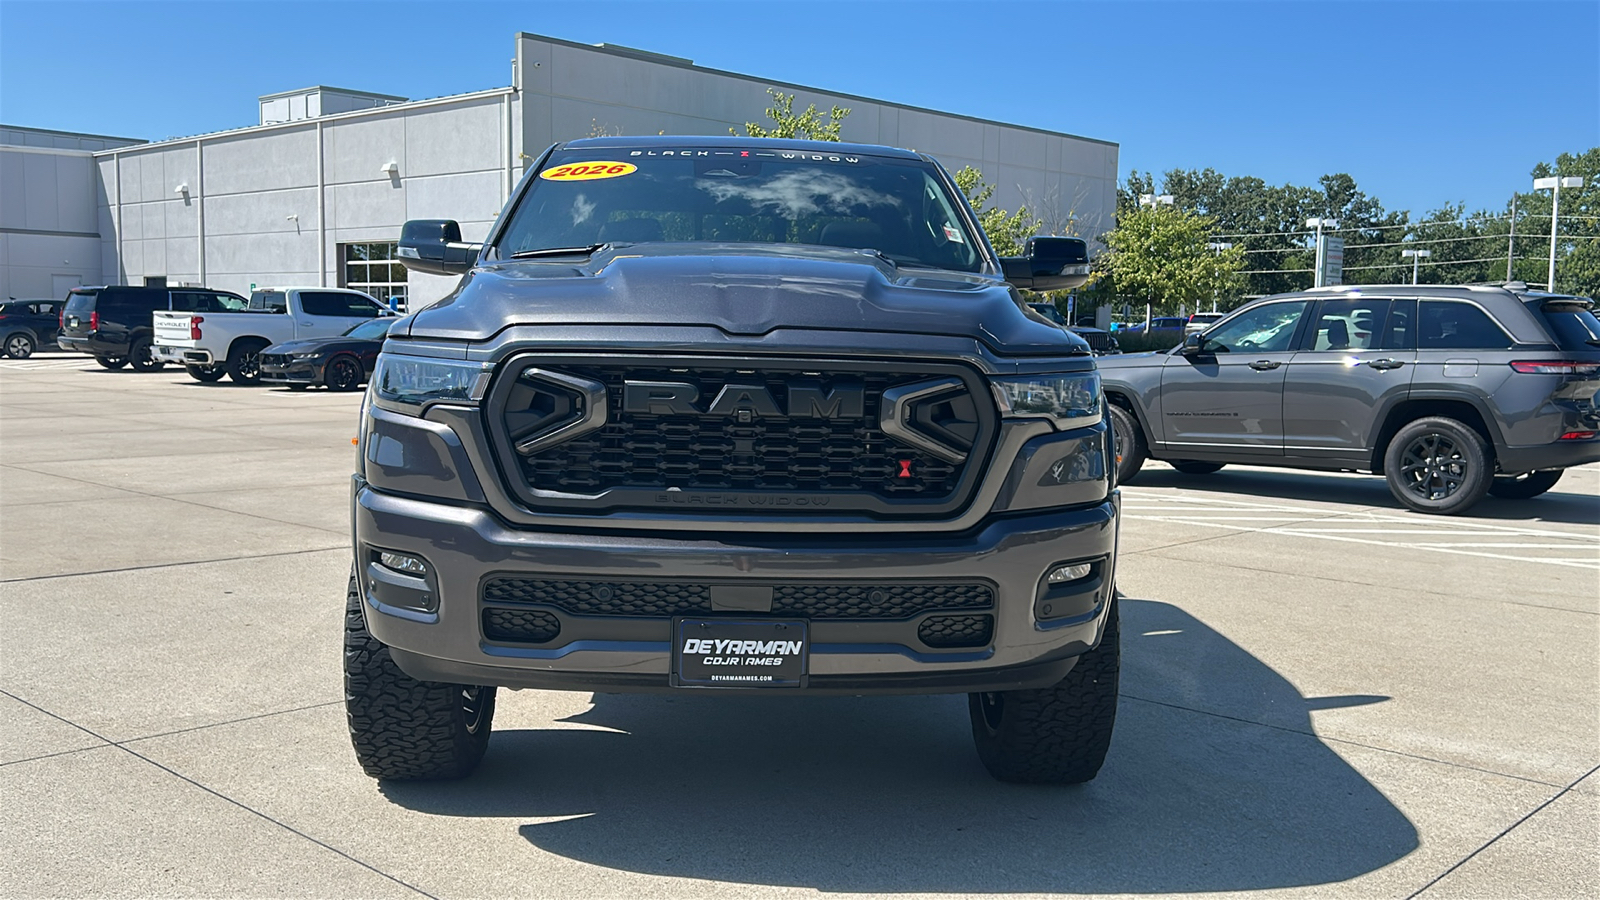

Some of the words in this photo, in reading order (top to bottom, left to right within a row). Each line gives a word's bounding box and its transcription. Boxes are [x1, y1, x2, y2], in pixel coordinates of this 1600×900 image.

[782, 153, 860, 163] WIDOW
[550, 164, 627, 178] 2026
[624, 379, 865, 418] RAM
[655, 492, 739, 505] BLACK
[748, 494, 831, 507] WIDOW
[683, 639, 802, 655] DEYARMAN
[703, 657, 739, 665] CDJR
[745, 657, 783, 665] AMES
